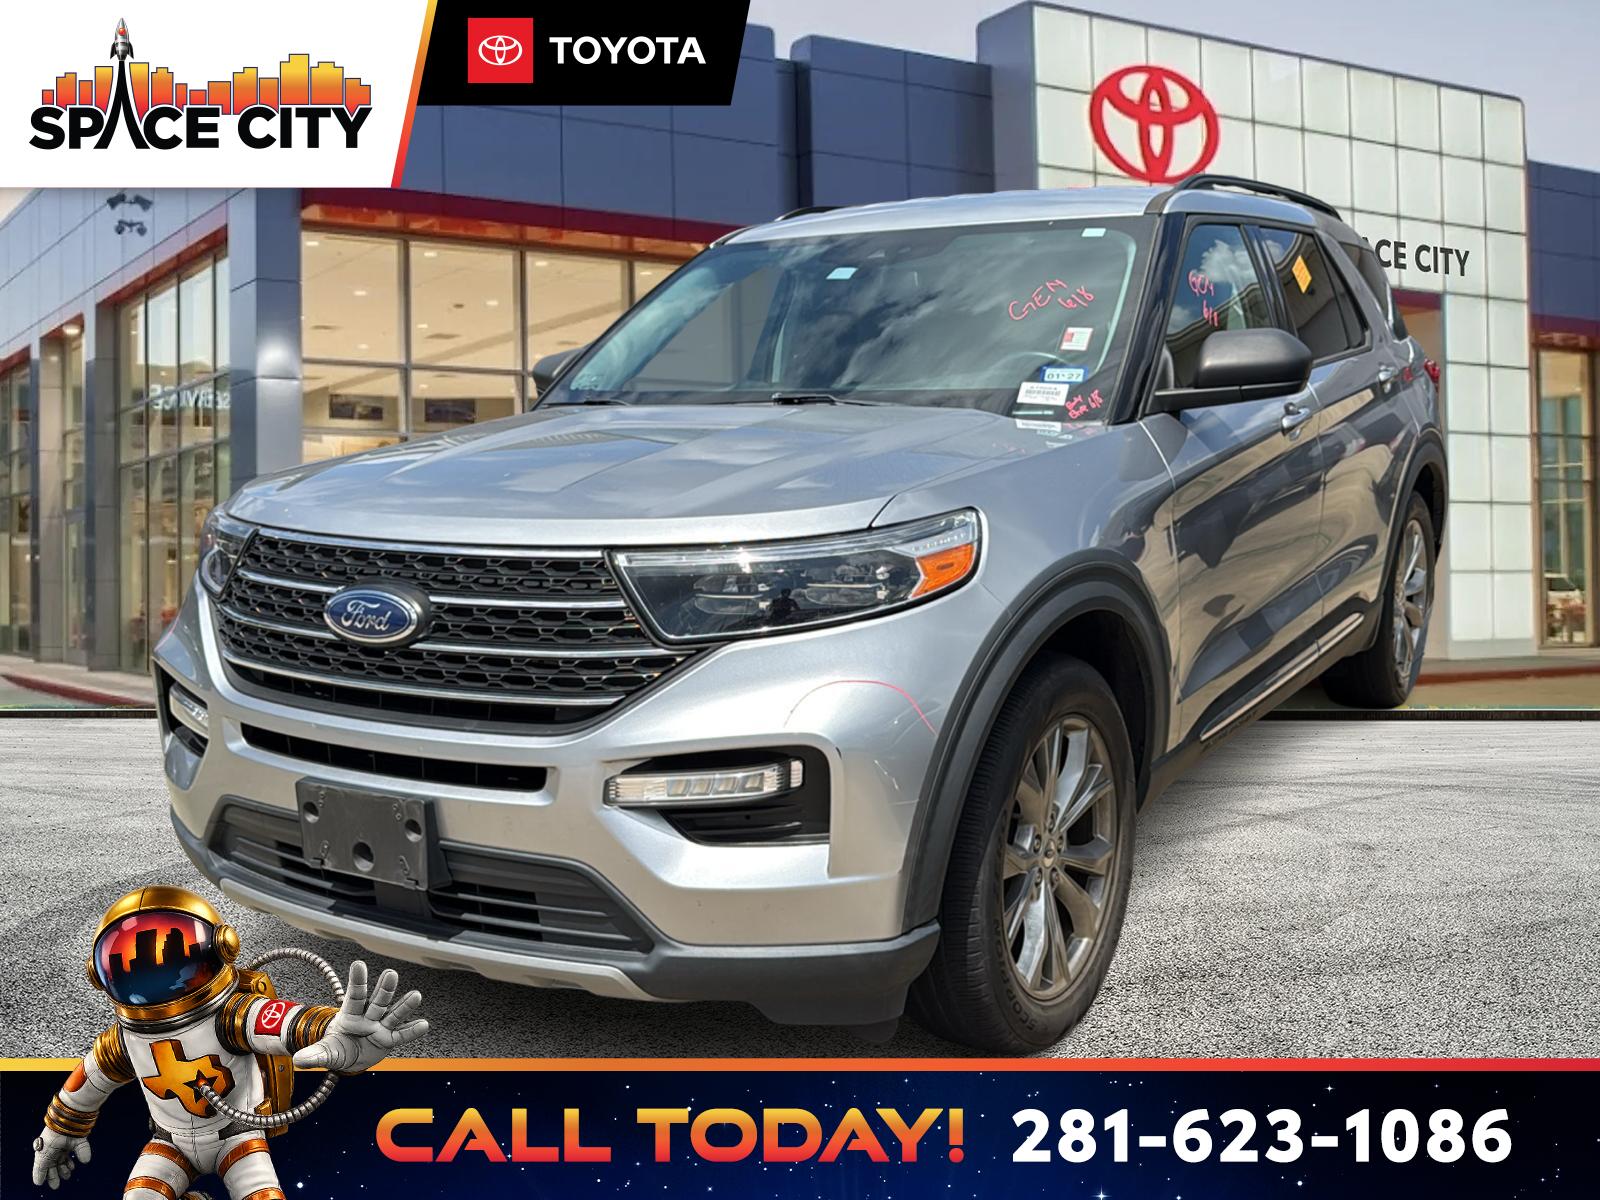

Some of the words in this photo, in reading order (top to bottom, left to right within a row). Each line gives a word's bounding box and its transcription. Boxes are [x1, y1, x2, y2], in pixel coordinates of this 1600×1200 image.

[1362, 237, 1408, 270] CE
[1414, 244, 1470, 277] CITY
[1008, 279, 1068, 321] GEN
[341, 599, 392, 631] Ford
